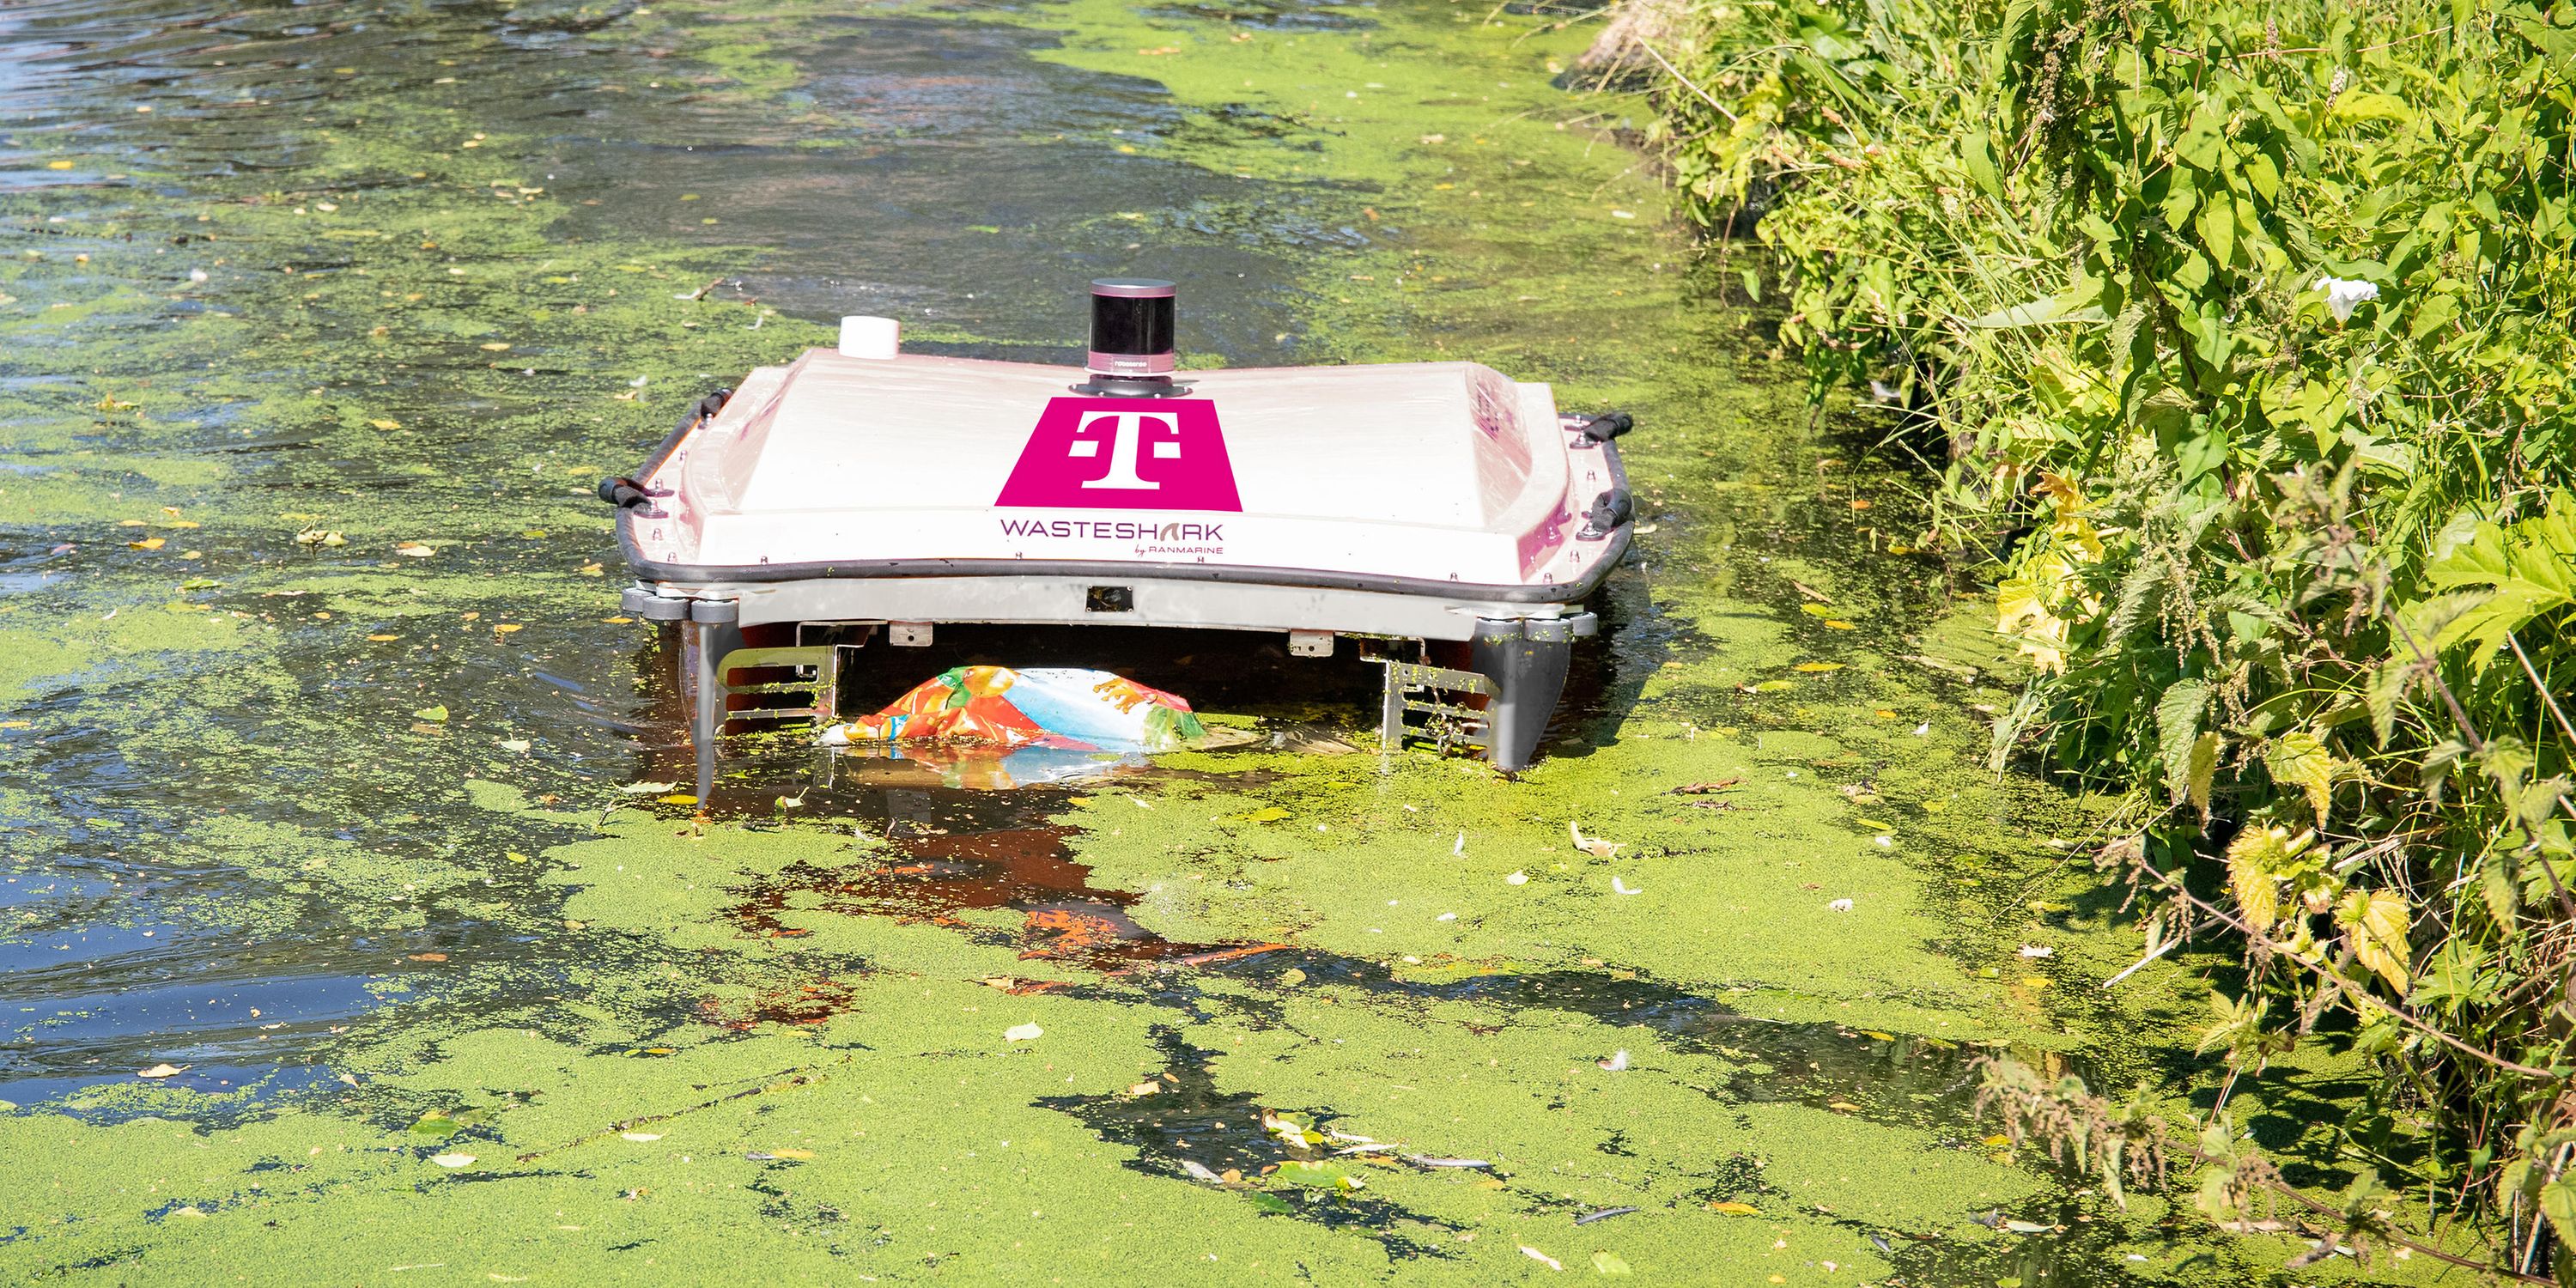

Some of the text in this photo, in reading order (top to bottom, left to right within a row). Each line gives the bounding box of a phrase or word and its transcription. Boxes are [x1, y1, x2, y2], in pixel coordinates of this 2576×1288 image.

[1068, 410, 1182, 490] T
[1134, 544, 1224, 557] by RANMARINE
